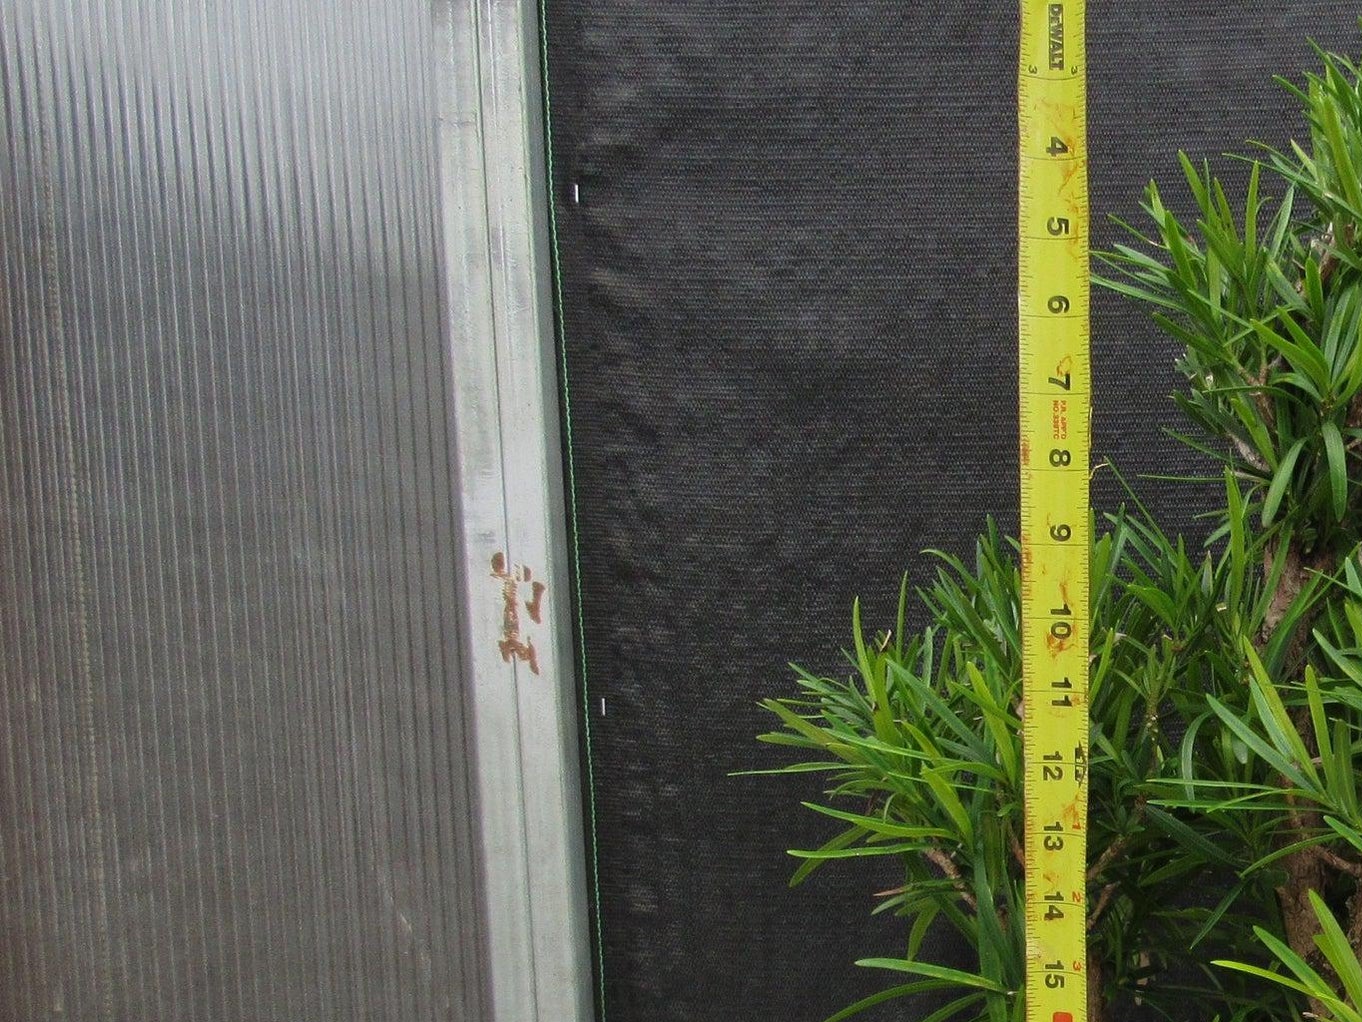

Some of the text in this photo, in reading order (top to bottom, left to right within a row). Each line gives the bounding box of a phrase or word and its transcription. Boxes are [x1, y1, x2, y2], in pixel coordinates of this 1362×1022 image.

[1046, 136, 1069, 157] 4
[1047, 217, 1069, 236] 5
[1047, 295, 1069, 314] 6
[1048, 374, 1070, 391] 7
[1049, 449, 1071, 468] 8
[1050, 524, 1071, 542] 9
[1051, 603, 1072, 640] 10
[1051, 677, 1073, 707] 11
[1043, 751, 1063, 781] 12
[1044, 821, 1064, 851] 13
[1045, 892, 1064, 921] 14
[1072, 891, 1082, 903] 2
[1045, 960, 1064, 989] 15
[1072, 961, 1082, 971] 3
